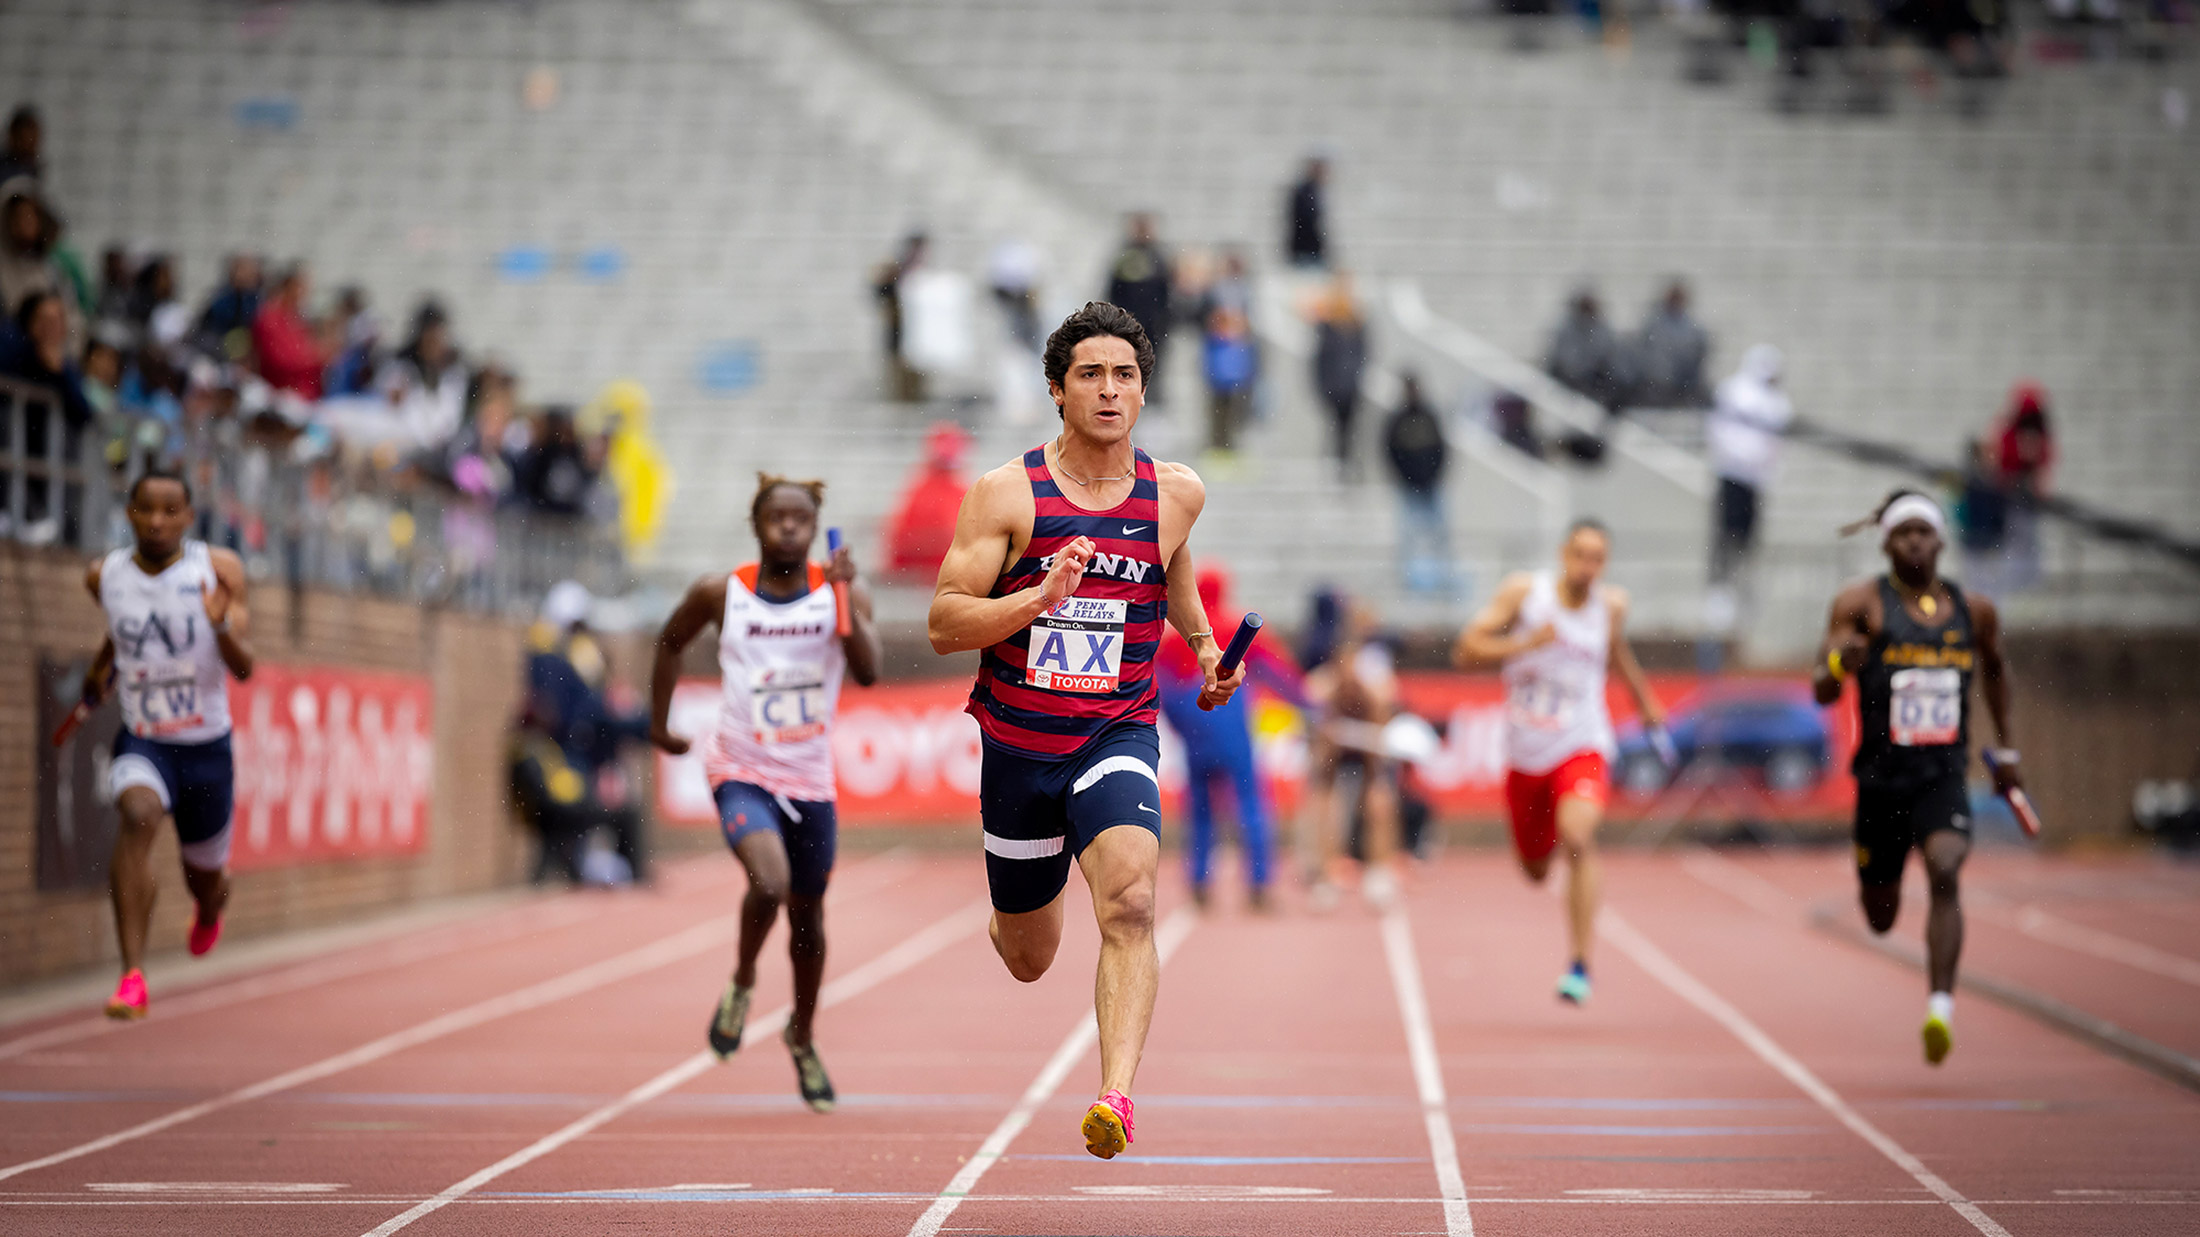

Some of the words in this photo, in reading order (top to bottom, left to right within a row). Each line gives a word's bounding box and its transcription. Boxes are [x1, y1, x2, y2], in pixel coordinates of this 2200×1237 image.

[1040, 552, 1152, 583] PNN
[1074, 601, 1107, 611] PENN
[1072, 609, 1115, 620] RELAYS
[1047, 620, 1071, 629] Dream
[116, 611, 195, 661] SAU
[1054, 676, 1109, 690] TOYOTA
